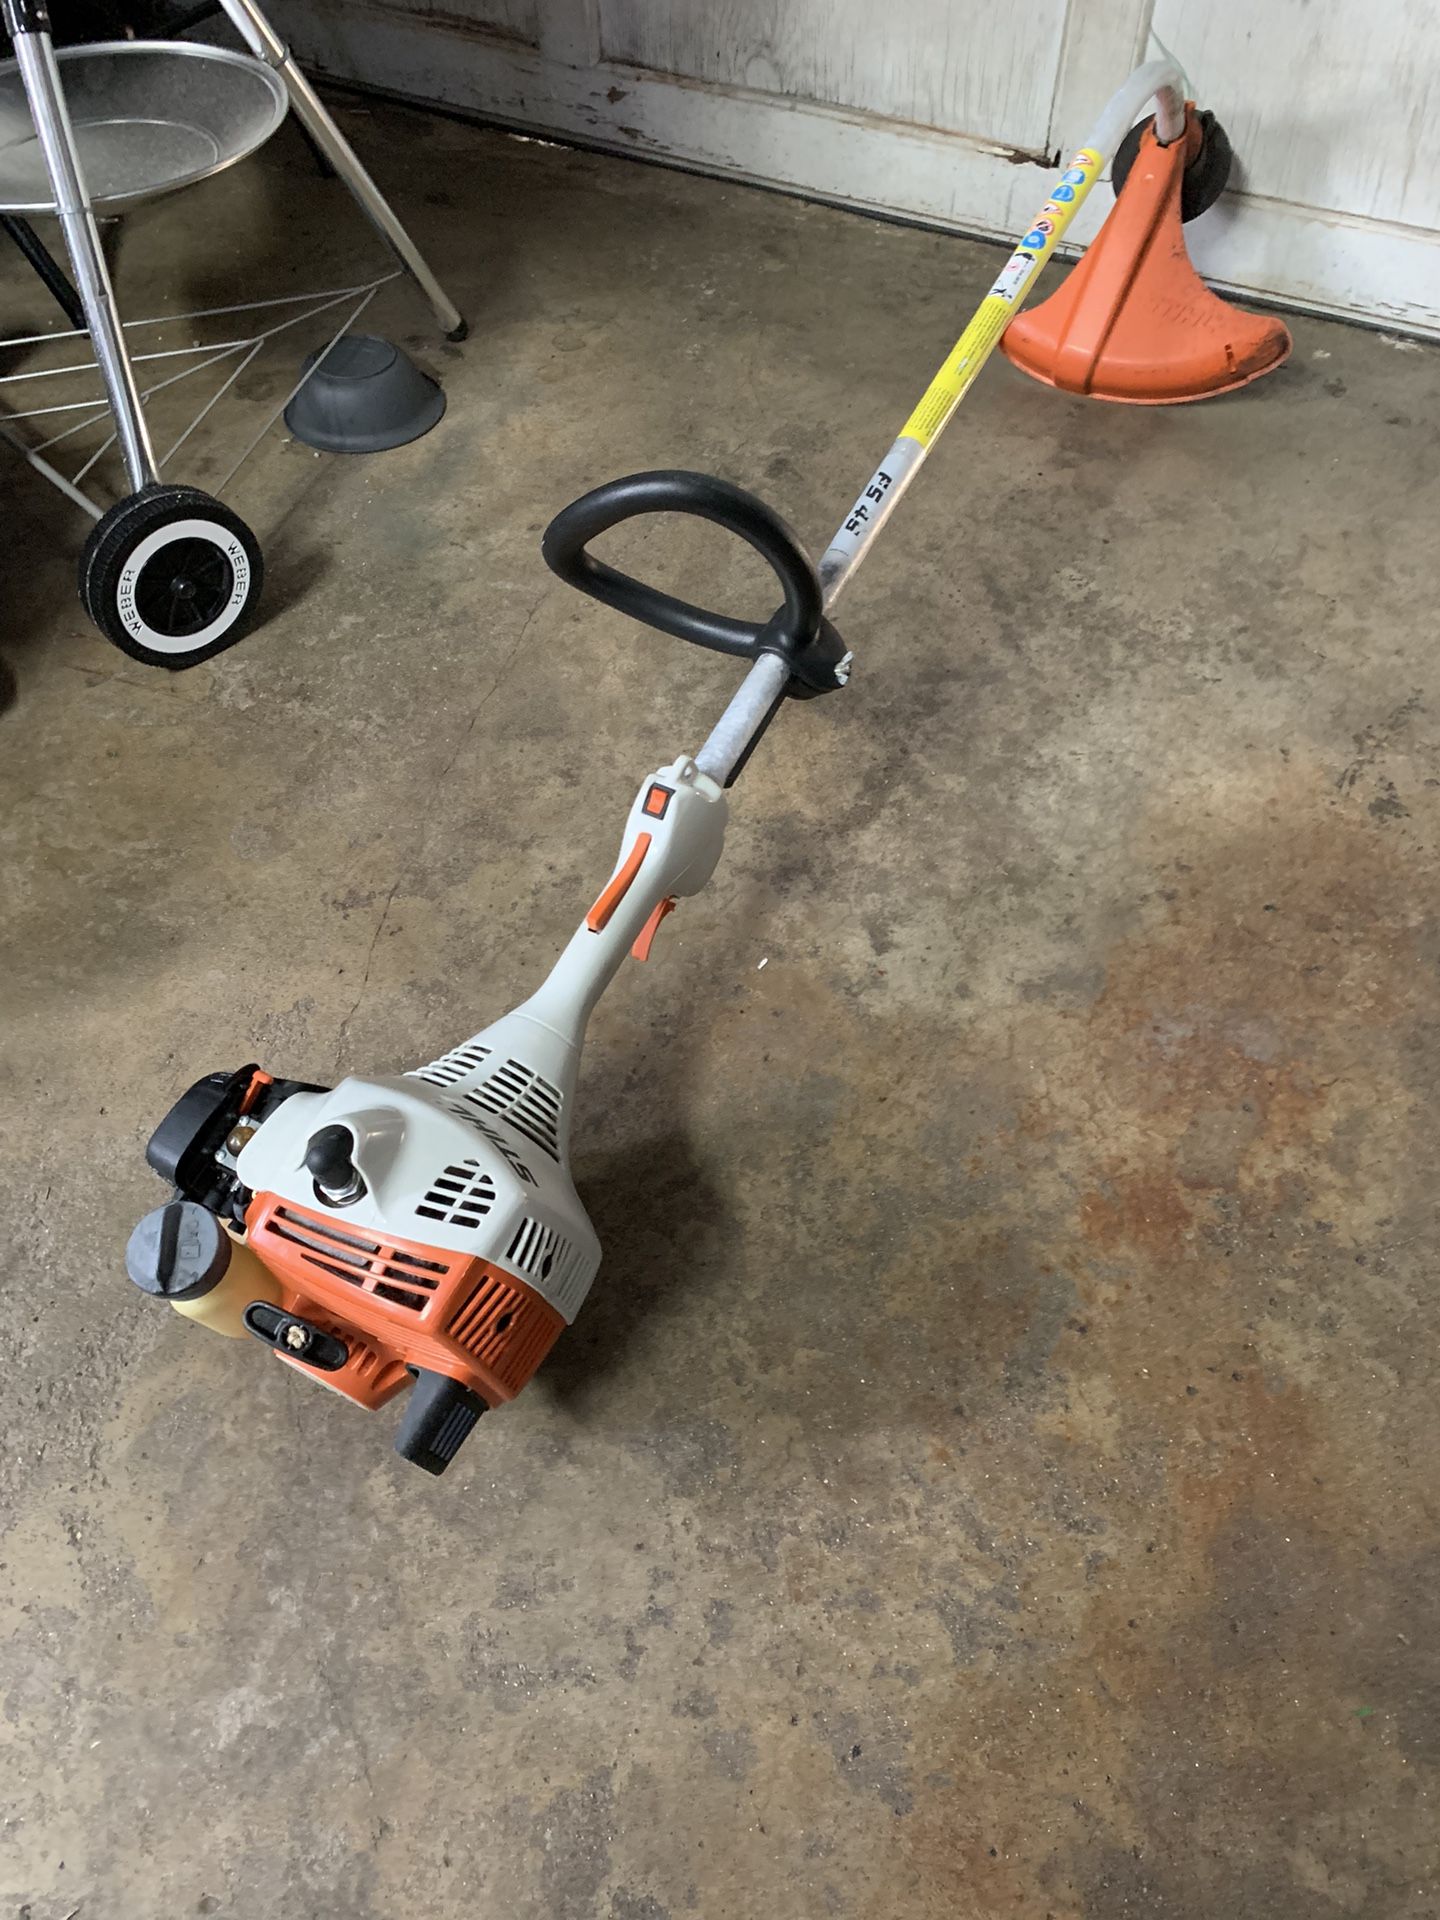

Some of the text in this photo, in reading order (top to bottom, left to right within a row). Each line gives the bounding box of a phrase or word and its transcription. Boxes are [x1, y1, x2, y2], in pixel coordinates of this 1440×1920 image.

[845, 471, 893, 536] FS 45
[120, 569, 143, 635] WEBER
[227, 541, 246, 606] WEBER
[448, 1103, 539, 1188] STIHL
